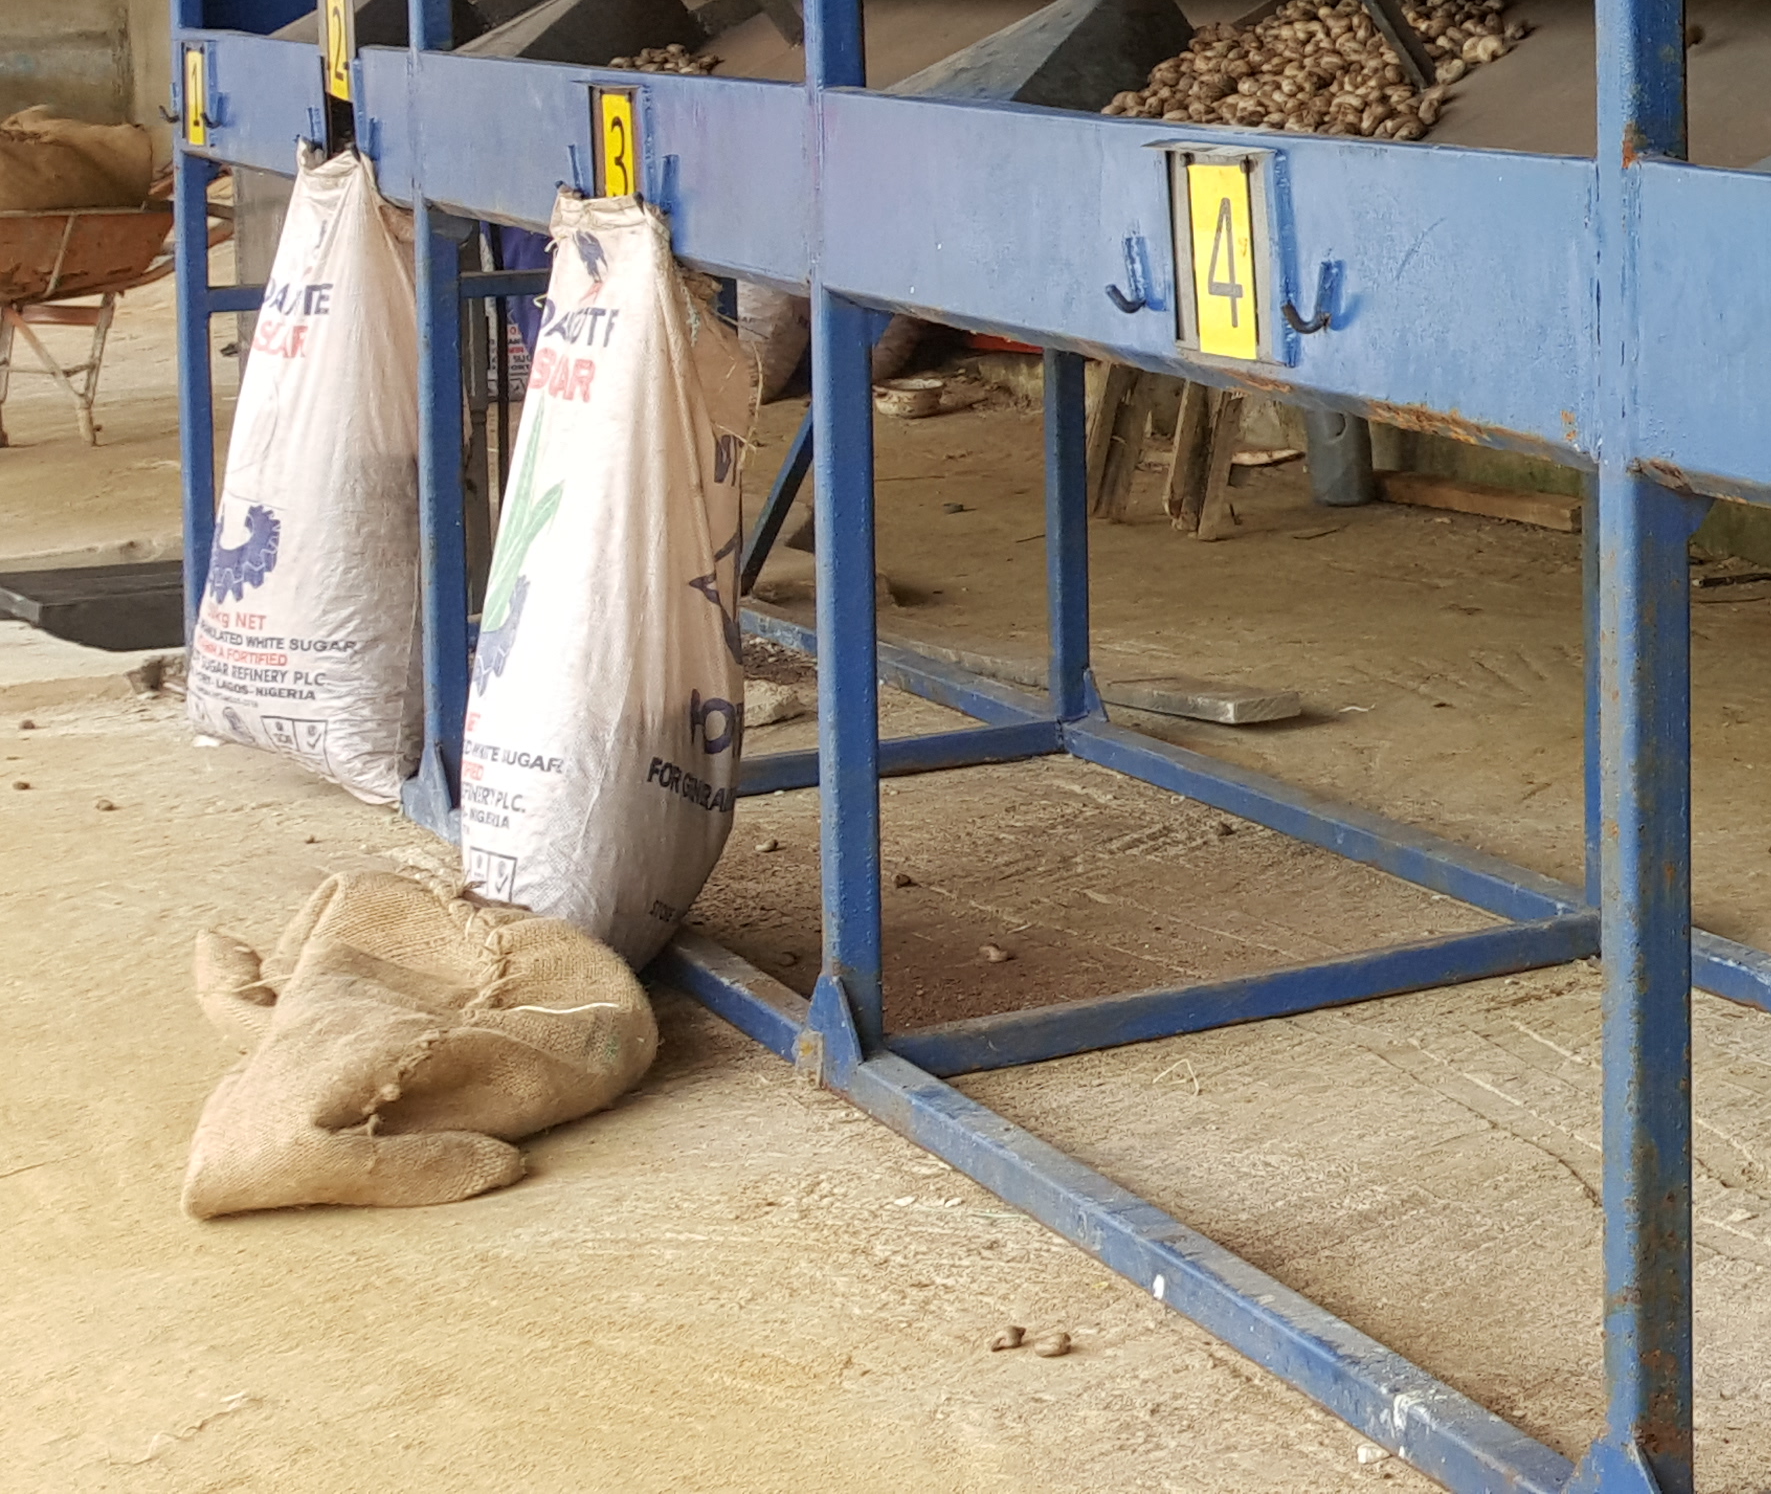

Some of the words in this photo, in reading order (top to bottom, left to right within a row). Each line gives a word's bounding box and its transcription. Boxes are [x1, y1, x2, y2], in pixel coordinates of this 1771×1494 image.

[332, 6, 344, 81] 2
[192, 62, 200, 127] 1
[611, 116, 628, 197] 3
[1208, 197, 1242, 327] 4
[235, 612, 267, 630] NET
[227, 649, 288, 667] FORTIFIED
[246, 637, 284, 650] WHITE
[289, 639, 357, 653] SUGAR
[232, 665, 288, 683] REFINERY
[647, 757, 682, 793] FOR
